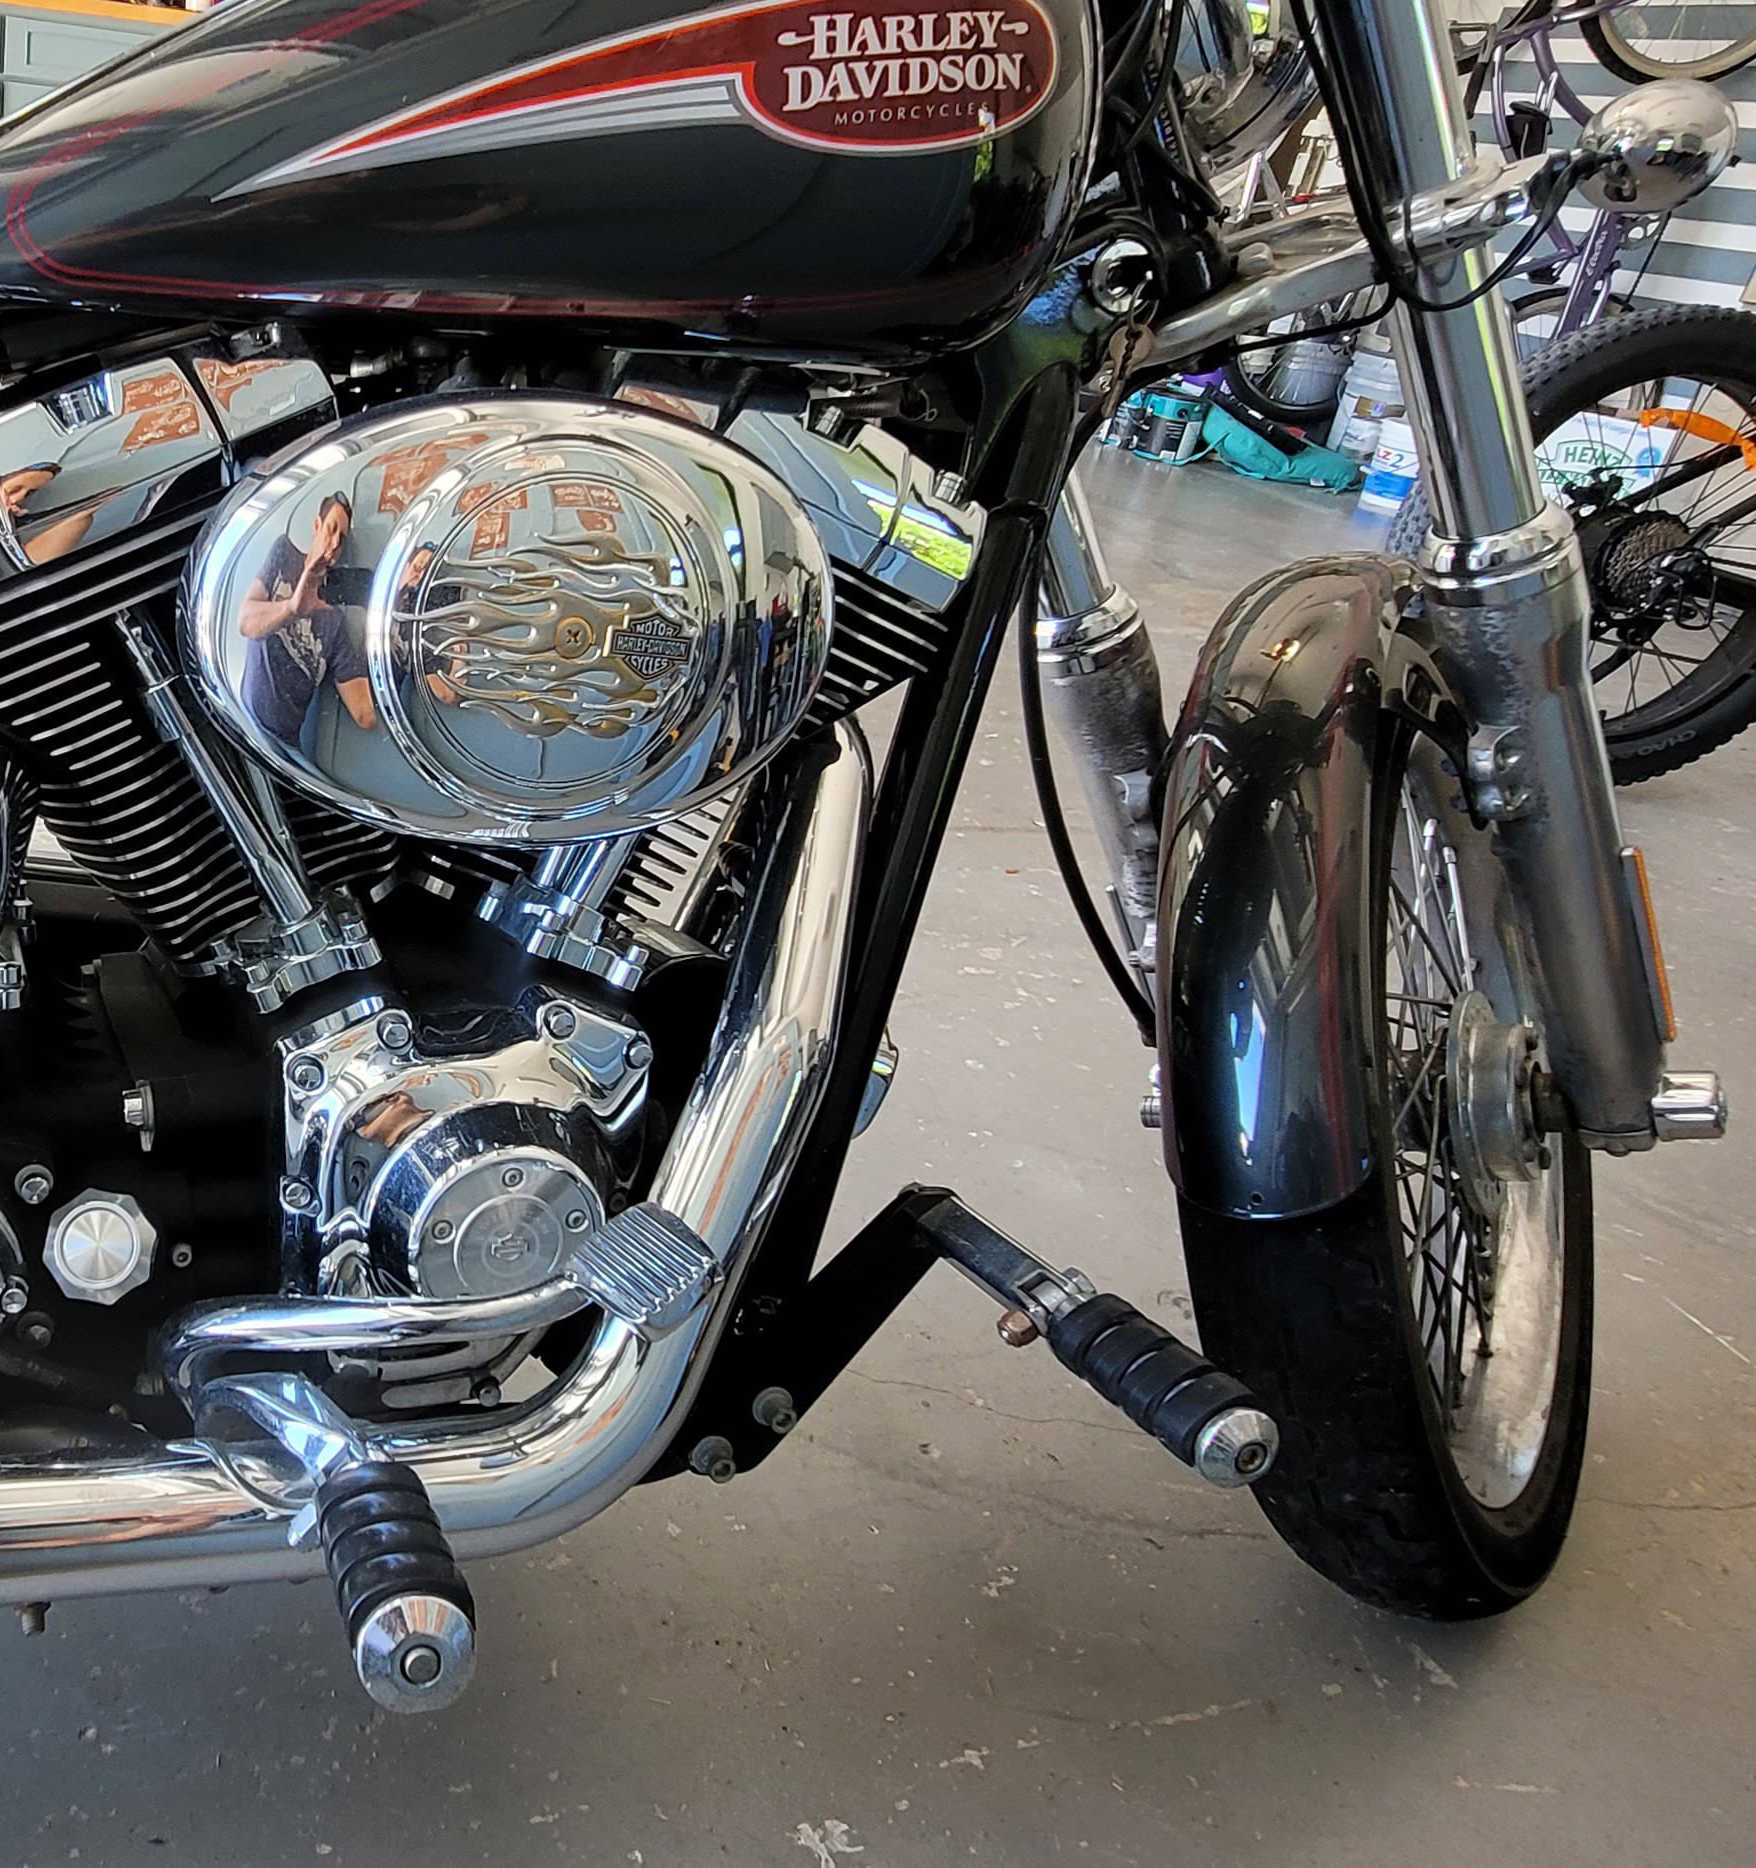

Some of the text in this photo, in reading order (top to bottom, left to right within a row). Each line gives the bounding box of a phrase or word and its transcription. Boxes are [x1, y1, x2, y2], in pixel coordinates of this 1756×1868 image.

[808, 10, 1006, 60] HARLEY
[782, 53, 1025, 112] DAVIDSON
[834, 101, 989, 126] MOTORCYCLES
[635, 619, 673, 637] MOTOR
[630, 655, 669, 675] CYCLES
